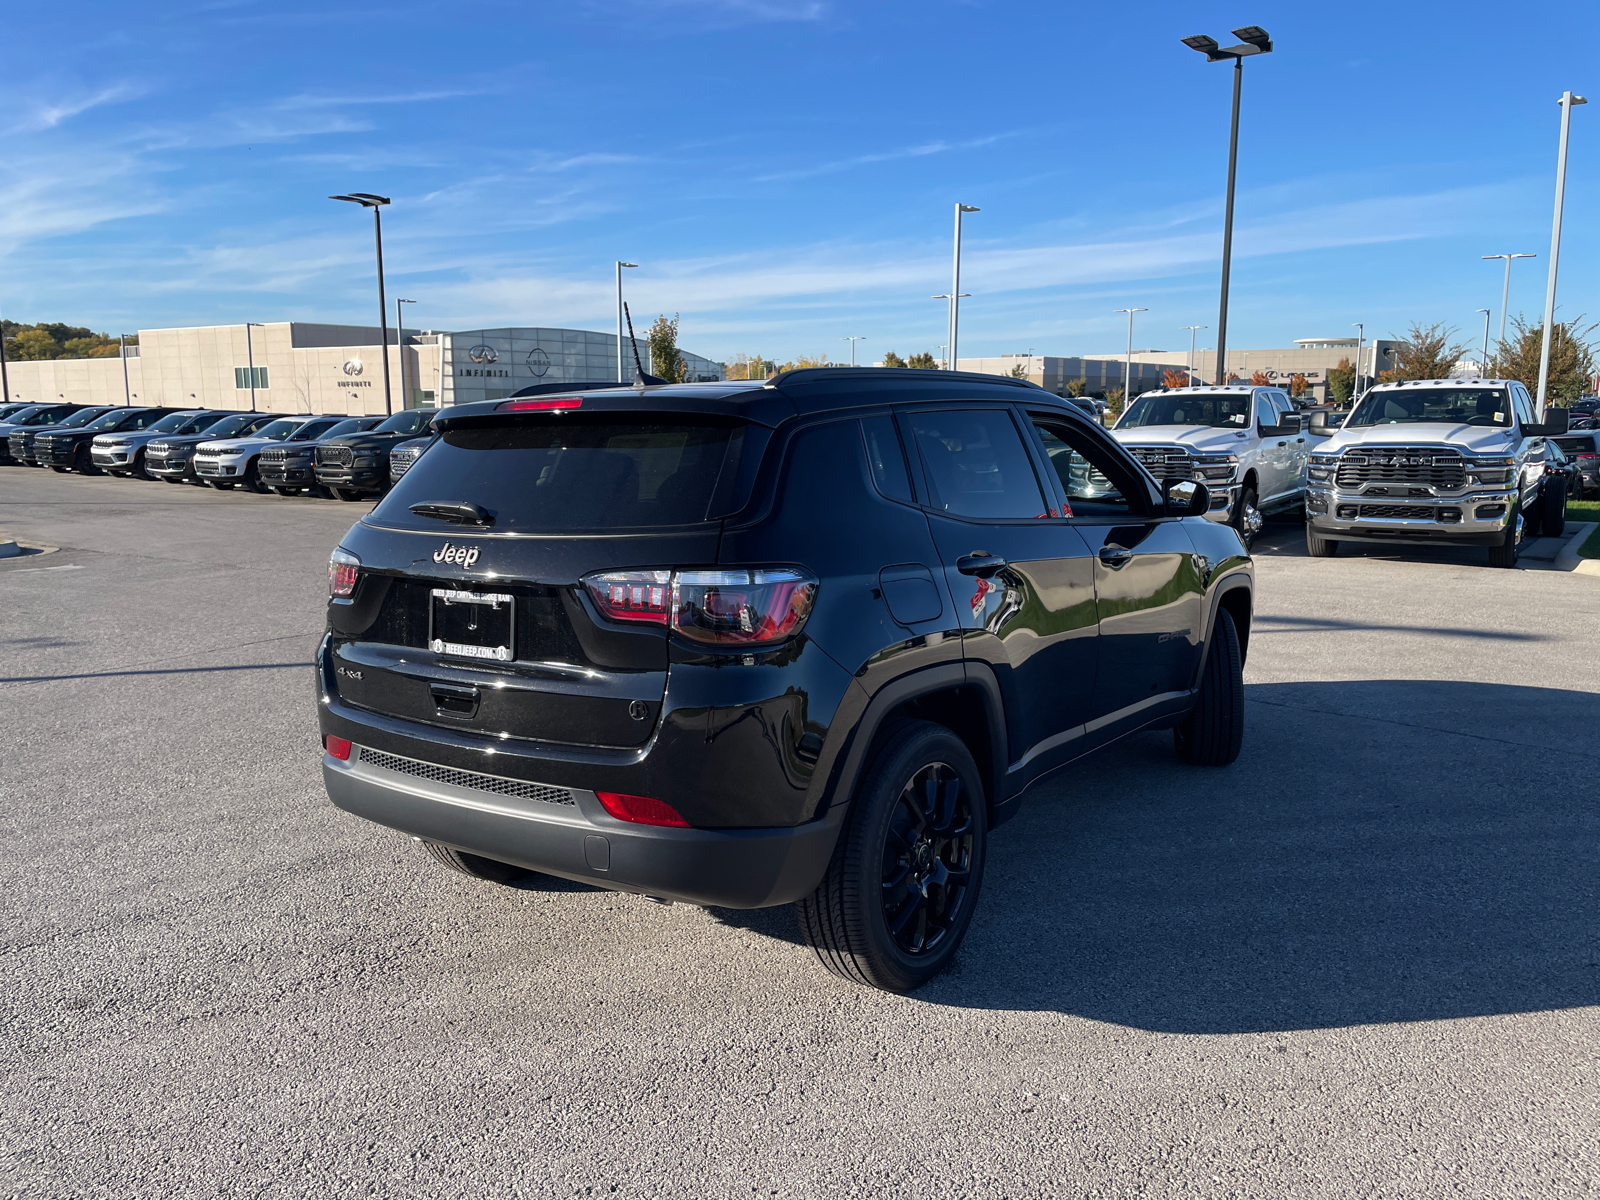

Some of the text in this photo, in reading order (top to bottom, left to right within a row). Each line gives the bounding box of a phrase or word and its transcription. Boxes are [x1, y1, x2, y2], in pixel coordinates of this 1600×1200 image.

[459, 368, 509, 378] INFINITI
[337, 380, 372, 388] INFINITI
[1368, 456, 1432, 466] RAM
[433, 542, 481, 569] Jeep
[446, 590, 457, 598] JEEP
[445, 645, 493, 659] REEDJEEP.COM
[337, 666, 364, 680] 4x4
